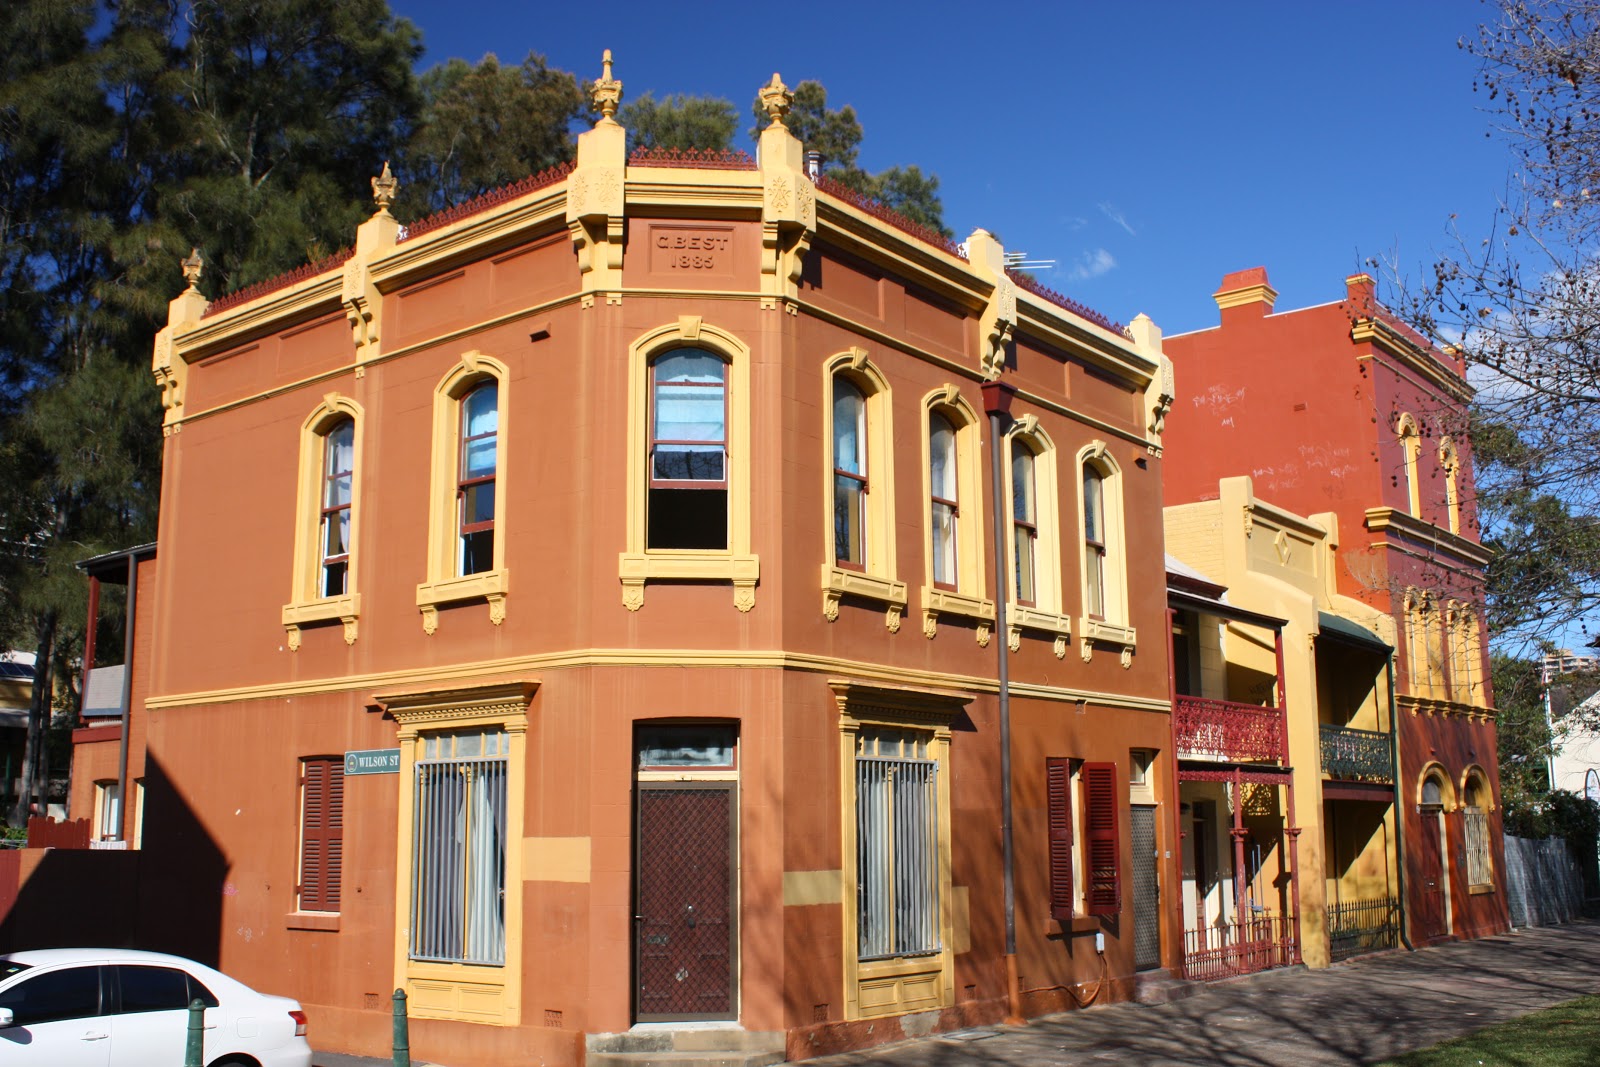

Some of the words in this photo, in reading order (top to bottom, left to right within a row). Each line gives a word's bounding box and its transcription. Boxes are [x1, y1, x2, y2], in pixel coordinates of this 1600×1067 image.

[671, 254, 714, 269] 1885
[359, 756, 388, 767] WILSON
[389, 755, 399, 766] ST
